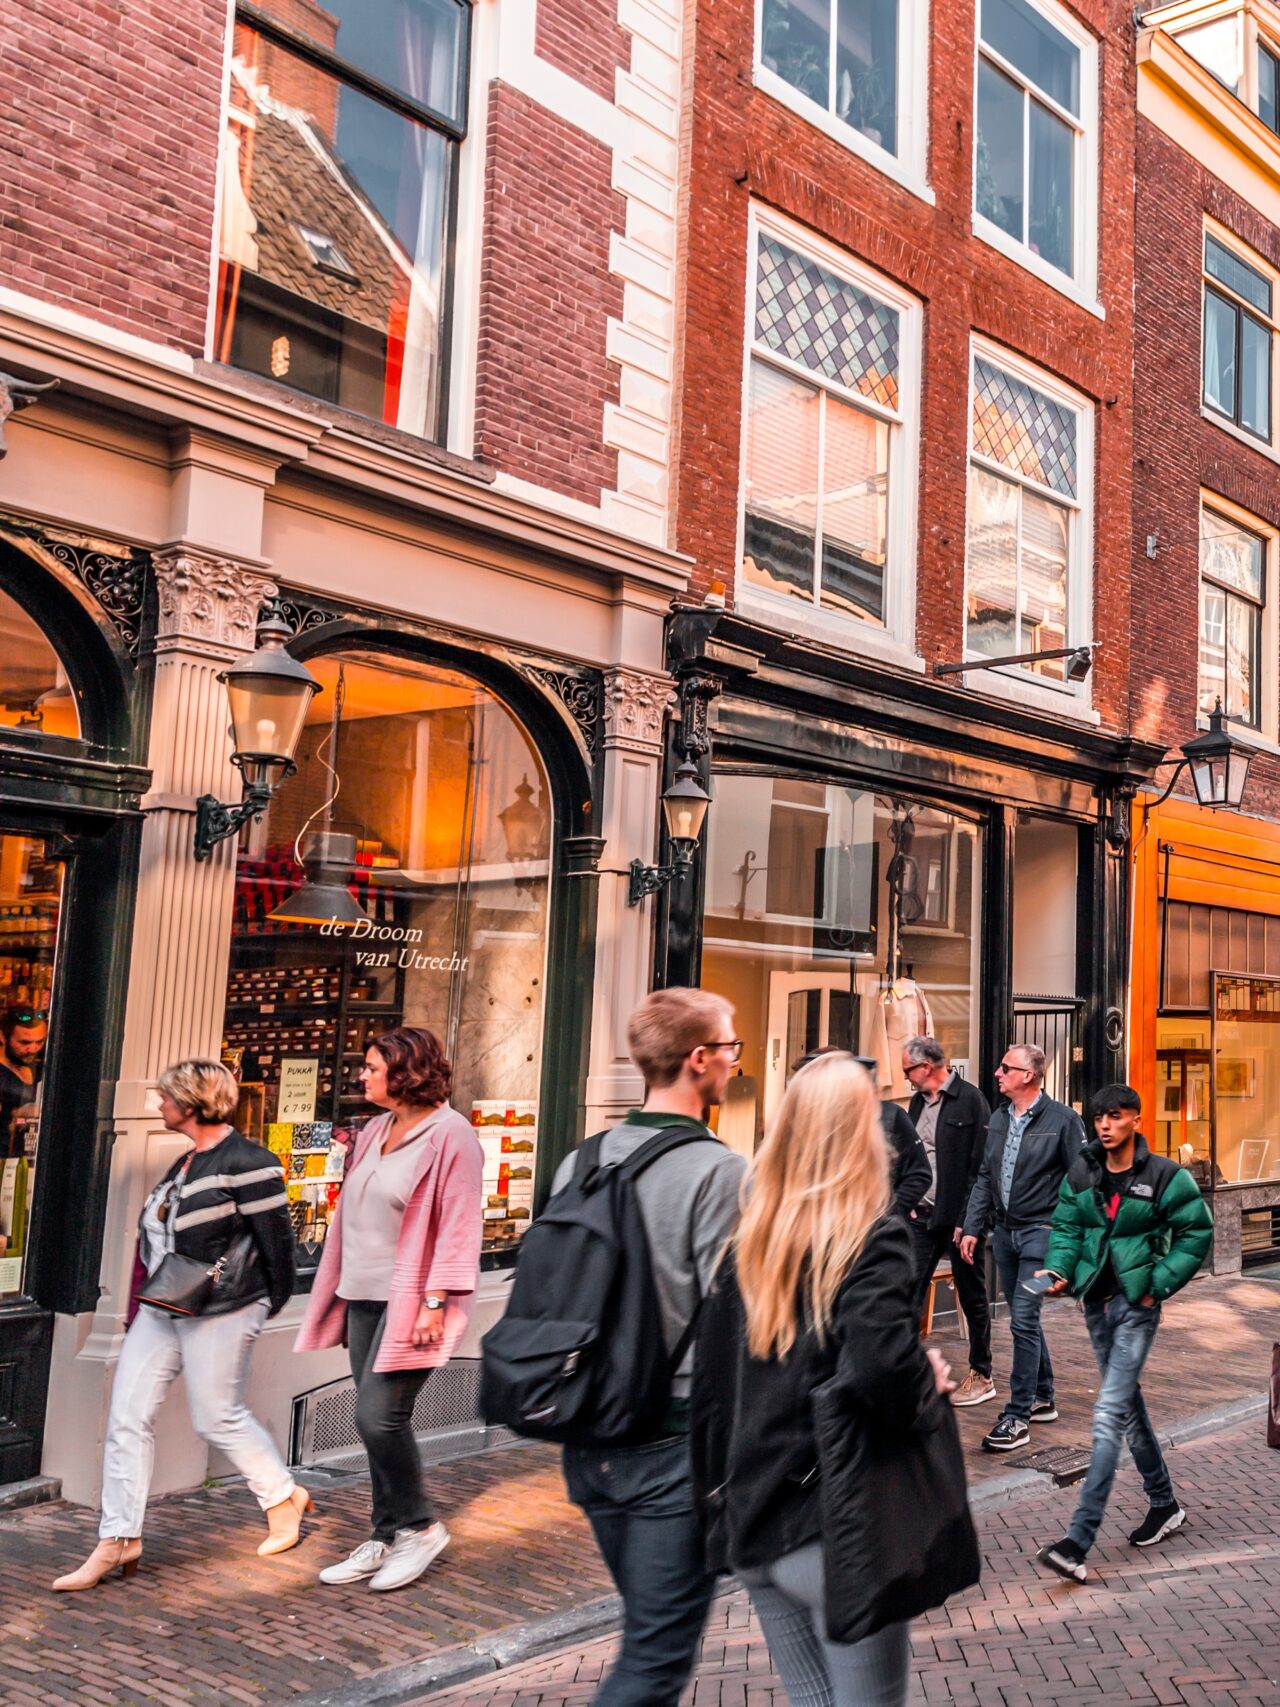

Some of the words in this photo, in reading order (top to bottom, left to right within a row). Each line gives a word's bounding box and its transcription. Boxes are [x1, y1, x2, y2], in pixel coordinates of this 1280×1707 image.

[319, 915, 345, 936] de
[350, 917, 423, 943] Droom
[355, 951, 390, 967] van
[398, 948, 469, 972] Utrecht
[287, 1067, 312, 1075] PUKKA
